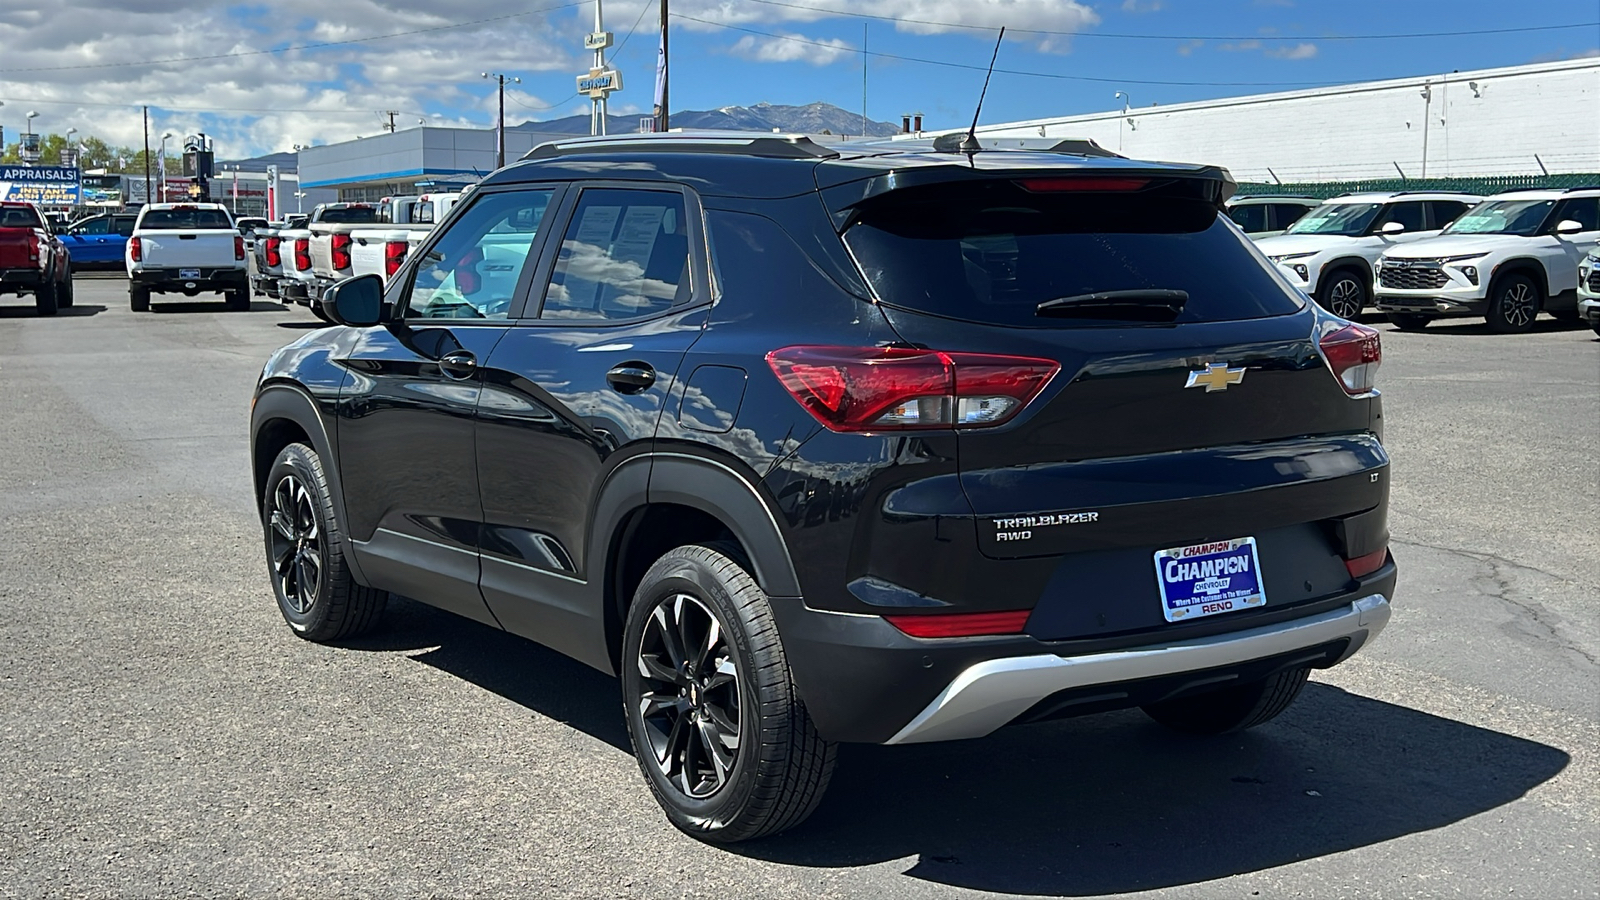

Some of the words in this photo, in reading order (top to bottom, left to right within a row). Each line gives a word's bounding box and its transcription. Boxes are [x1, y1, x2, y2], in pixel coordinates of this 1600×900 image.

[4, 169, 77, 180] APPRAISALS!
[993, 511, 1099, 529] TRAILBLAZER
[996, 530, 1032, 542] AWD
[1183, 541, 1230, 557] CHAMPION
[1165, 554, 1249, 583] CHAMPION
[1195, 579, 1228, 591] CHEVROLET
[1191, 596, 1201, 604] The
[1201, 593, 1223, 603] Customer
[1228, 591, 1236, 599] The
[1202, 601, 1233, 614] RENO
